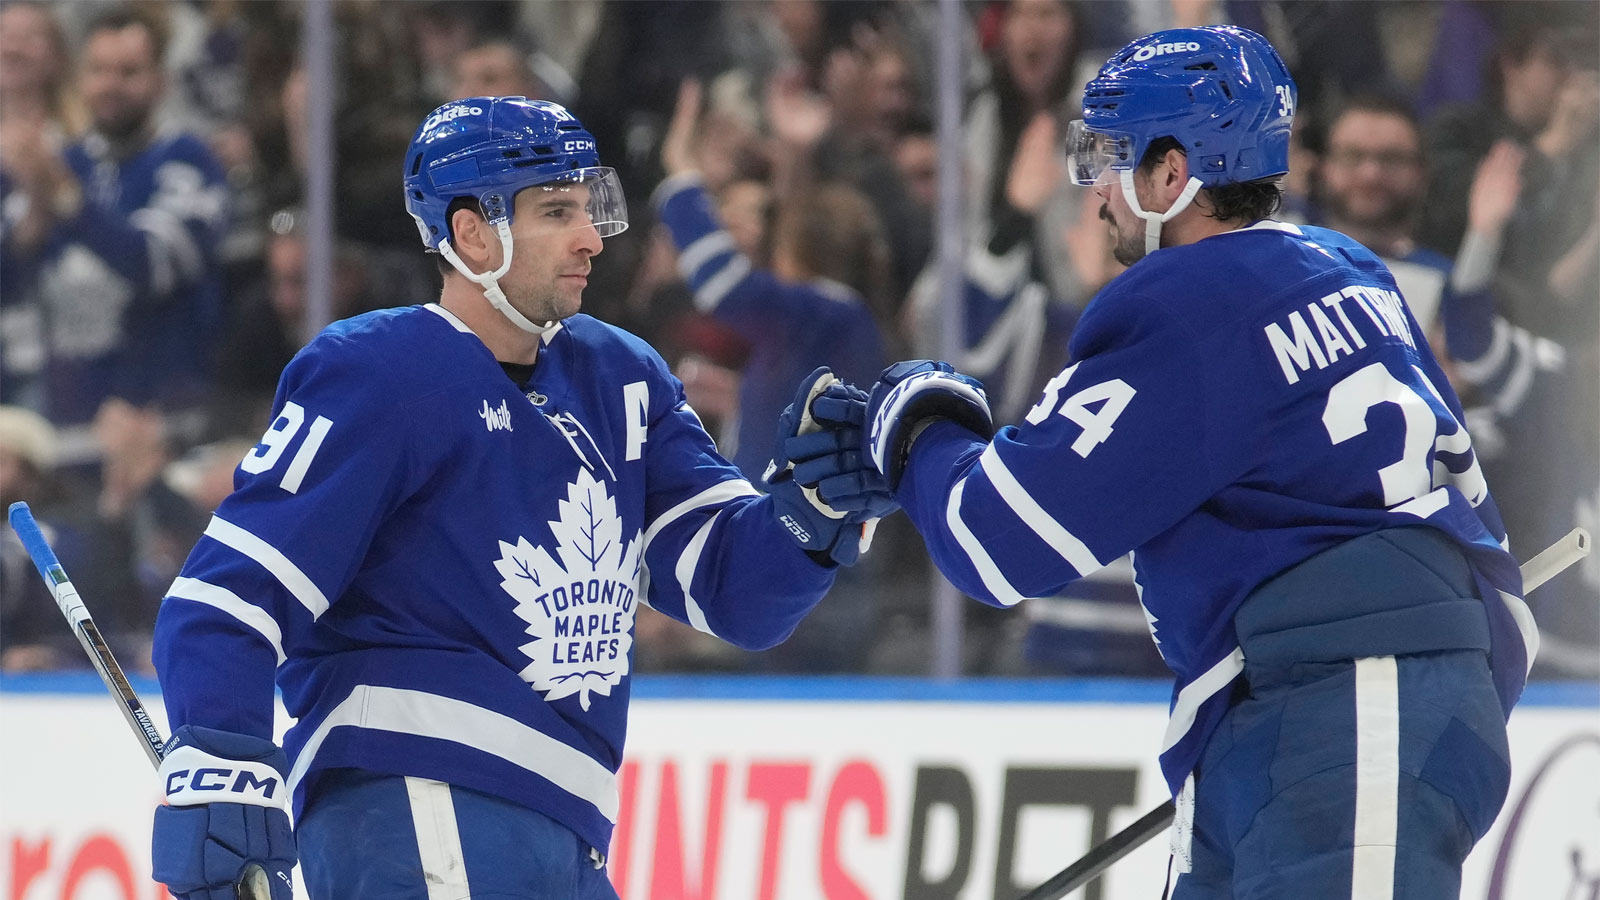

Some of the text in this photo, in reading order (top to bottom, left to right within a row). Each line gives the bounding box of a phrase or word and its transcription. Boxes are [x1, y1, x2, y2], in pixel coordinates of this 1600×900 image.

[1133, 42, 1200, 62] OREO
[1275, 84, 1294, 117] 34
[423, 106, 483, 132] OREO
[564, 141, 593, 151] CCM
[1264, 285, 1417, 385] MATTH
[623, 380, 650, 462] A
[240, 400, 335, 495] 91
[779, 515, 809, 543] CCM
[534, 578, 634, 619] TORONTO
[554, 611, 623, 638] MAPLE
[552, 638, 620, 664] LEAFS
[134, 707, 160, 743] TAVARES
[165, 767, 278, 799] CCM
[276, 870, 295, 893] CC
